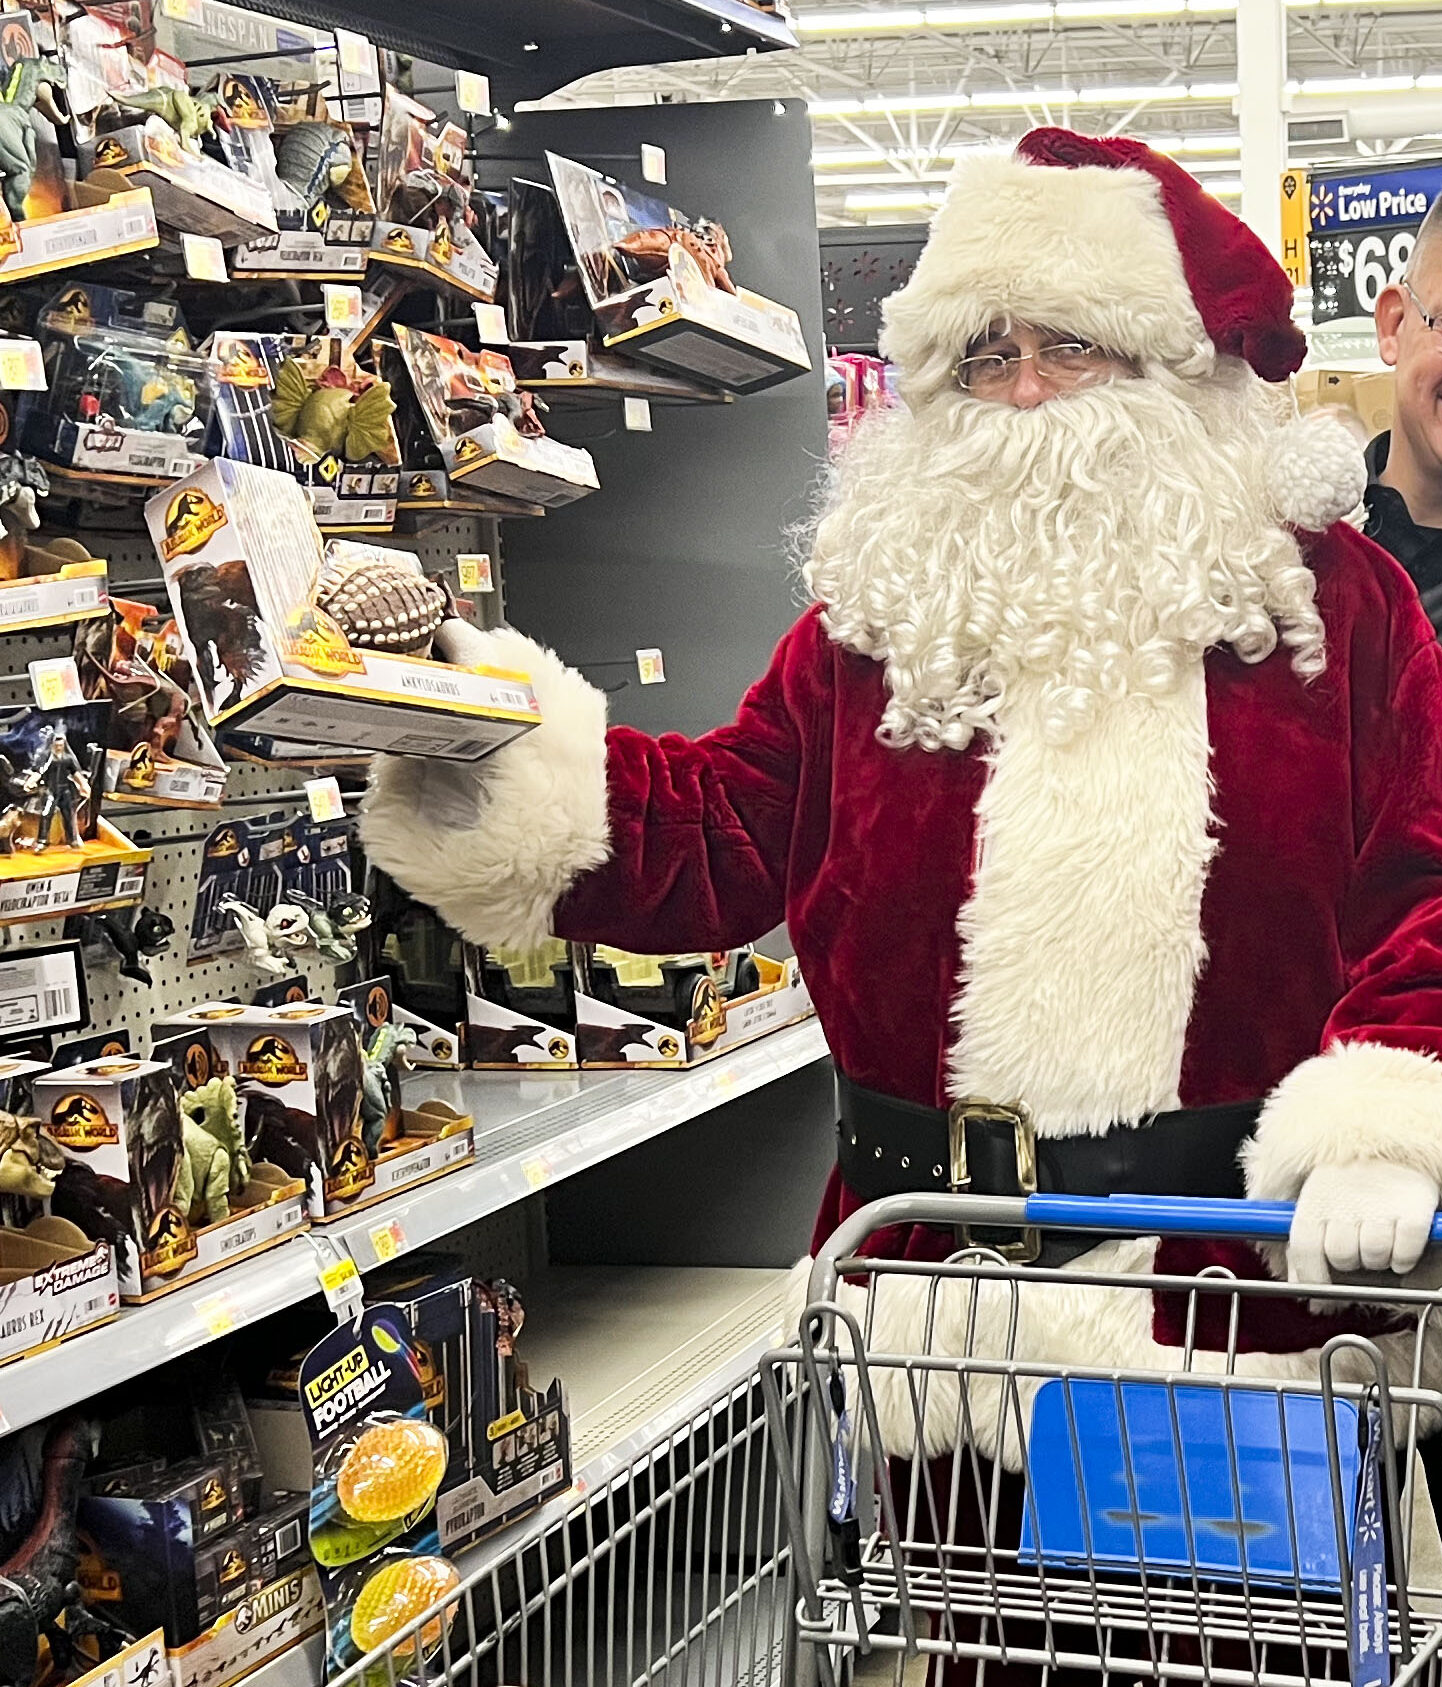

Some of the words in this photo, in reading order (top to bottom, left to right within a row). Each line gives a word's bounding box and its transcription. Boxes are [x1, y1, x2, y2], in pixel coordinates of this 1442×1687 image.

[1338, 197, 1377, 221] Low
[1379, 188, 1427, 217] Price
[1285, 239, 1298, 259] H
[84, 1124, 117, 1138] WORLD
[34, 1256, 101, 1292] EXTREME
[54, 1264, 109, 1293] DAMAGE
[30, 1308, 45, 1327] REX
[308, 1351, 364, 1403] LIGHT-UP
[312, 1360, 392, 1430] FOOTBALL
[80, 1574, 118, 1592] ORLD
[252, 1578, 301, 1623] MINIS
[1358, 1593, 1369, 1620] seat
[1373, 1610, 1385, 1654] Always
